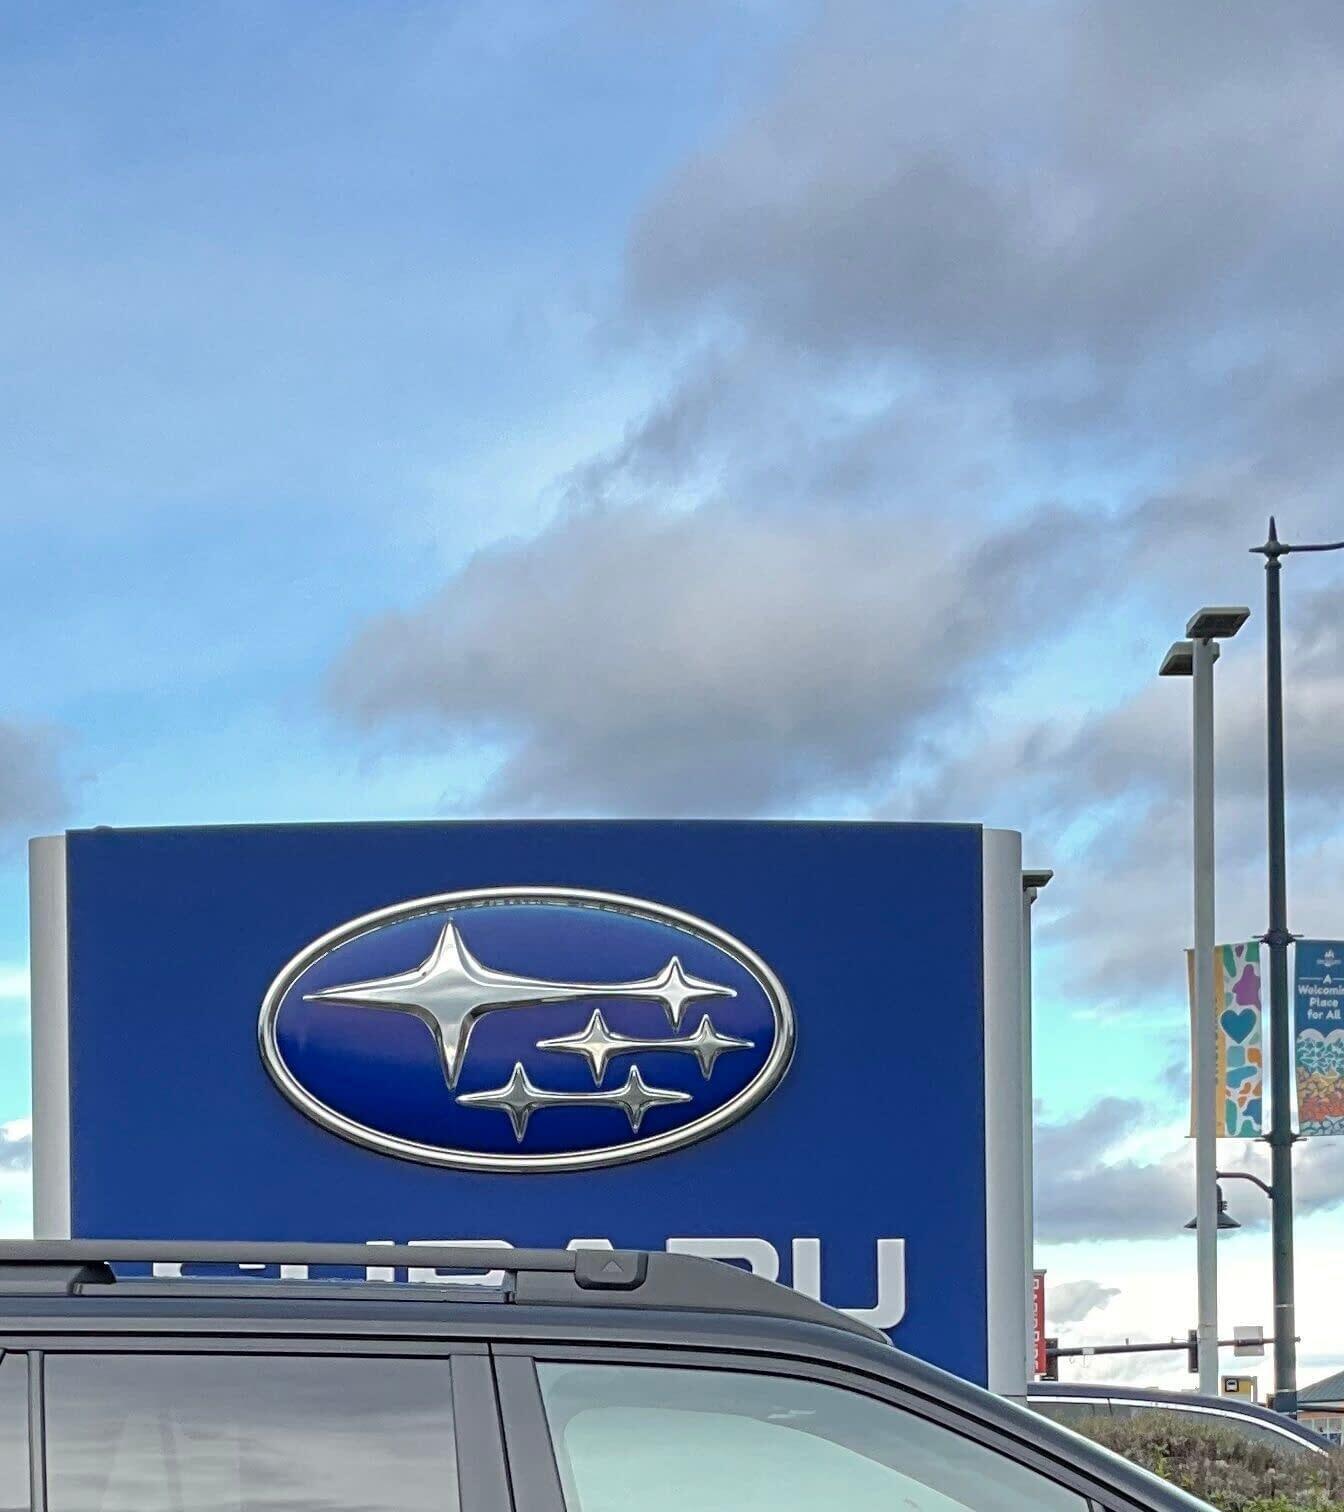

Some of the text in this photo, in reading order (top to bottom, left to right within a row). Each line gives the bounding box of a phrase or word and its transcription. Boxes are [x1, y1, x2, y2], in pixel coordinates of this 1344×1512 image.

[1323, 974, 1332, 984] A
[1309, 997, 1339, 1007] Place
[1307, 1009, 1342, 1020] for All
